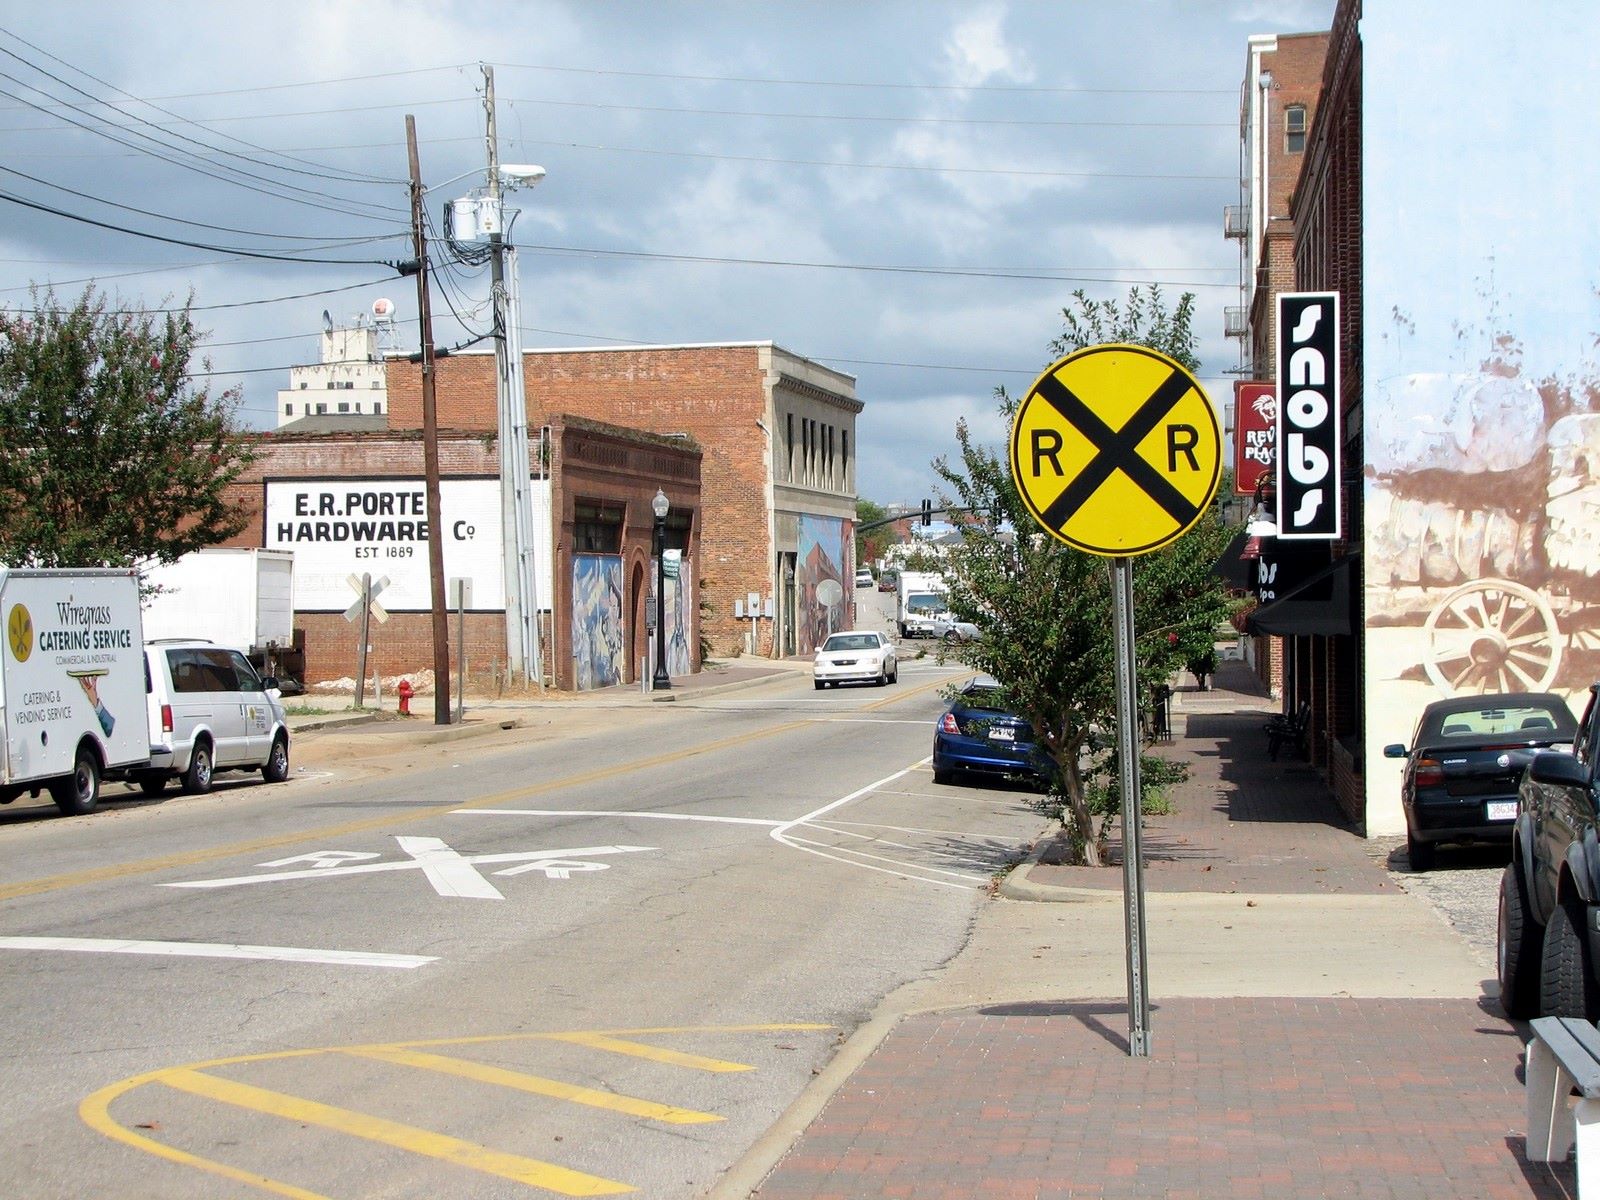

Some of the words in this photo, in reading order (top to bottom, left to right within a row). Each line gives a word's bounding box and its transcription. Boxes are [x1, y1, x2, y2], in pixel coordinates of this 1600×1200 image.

[1246, 425, 1276, 447] REV
[1031, 428, 1064, 477] R
[1167, 424, 1200, 472] R
[1245, 446, 1276, 465] PLAC
[295, 491, 425, 516] E.R.PORTE
[277, 520, 430, 542] HARDWARE
[386, 546, 413, 558] 1889
[1258, 556, 1278, 584] bs
[56, 595, 111, 631] Wiregrass
[39, 632, 90, 652] CATERING
[94, 629, 131, 649] SERVICE
[23, 691, 54, 706] CATERING
[56, 690, 61, 702] &
[15, 709, 45, 724] VENDING
[47, 706, 72, 721] SERVICE
